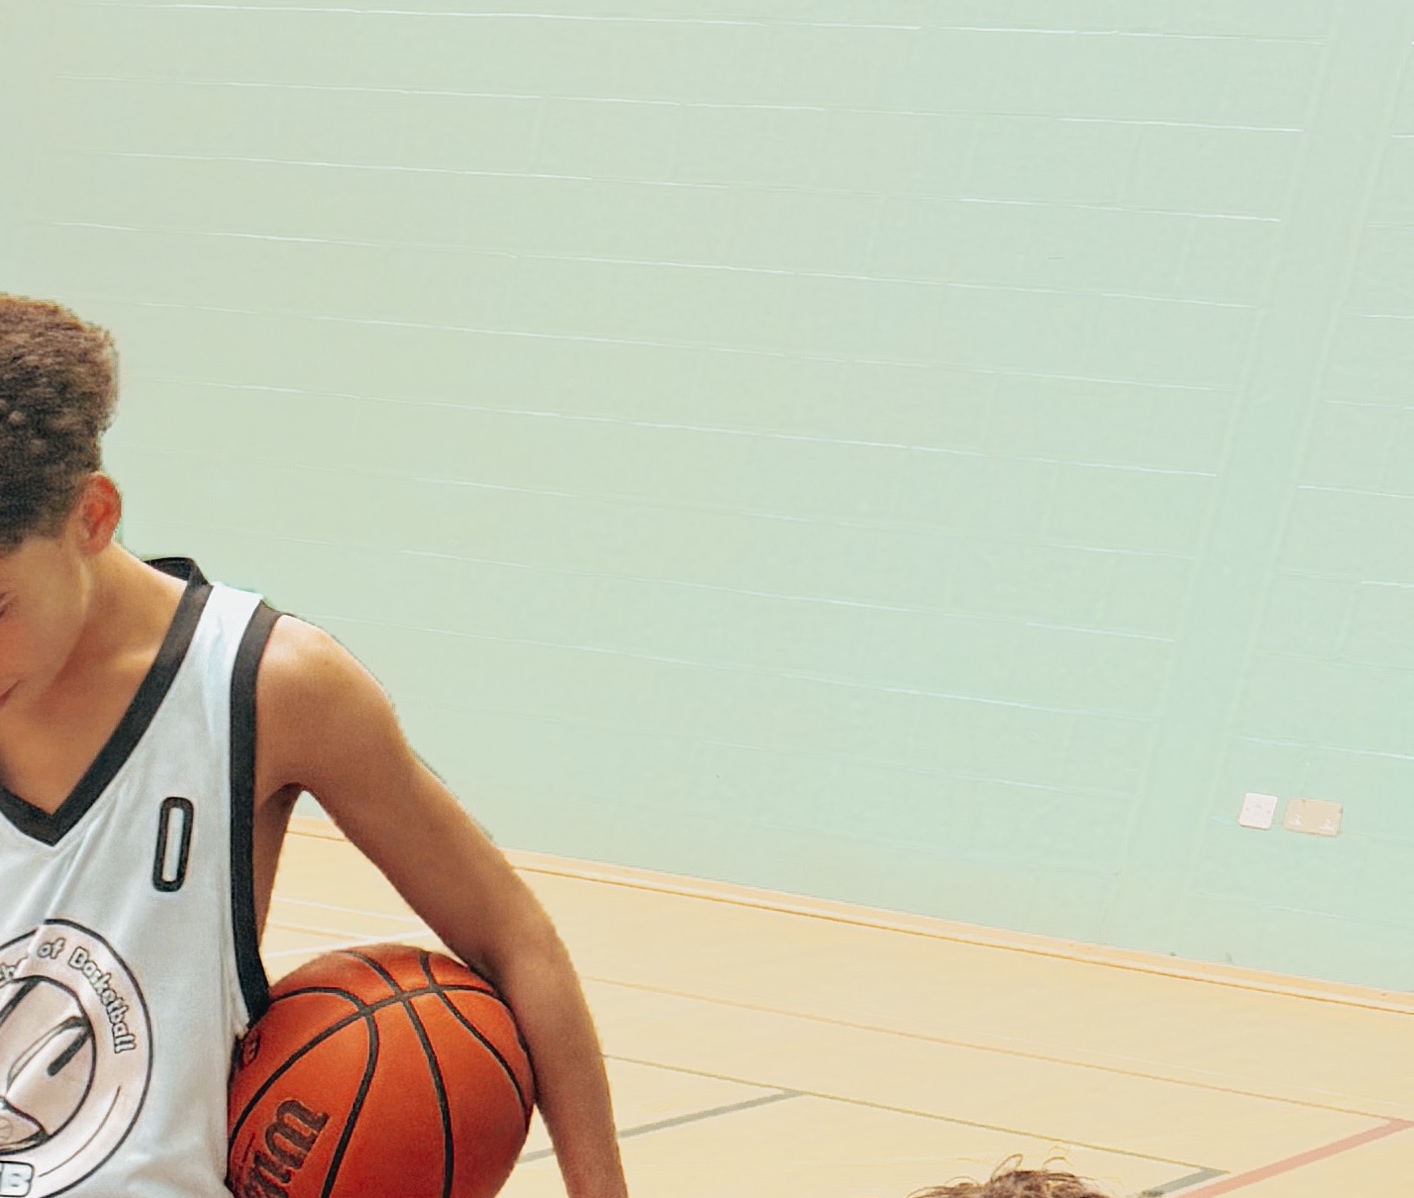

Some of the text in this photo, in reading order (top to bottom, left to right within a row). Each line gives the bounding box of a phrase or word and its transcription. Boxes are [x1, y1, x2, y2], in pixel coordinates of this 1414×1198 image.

[152, 796, 194, 892] 0
[37, 937, 66, 960] of
[68, 946, 137, 1054] Basketball
